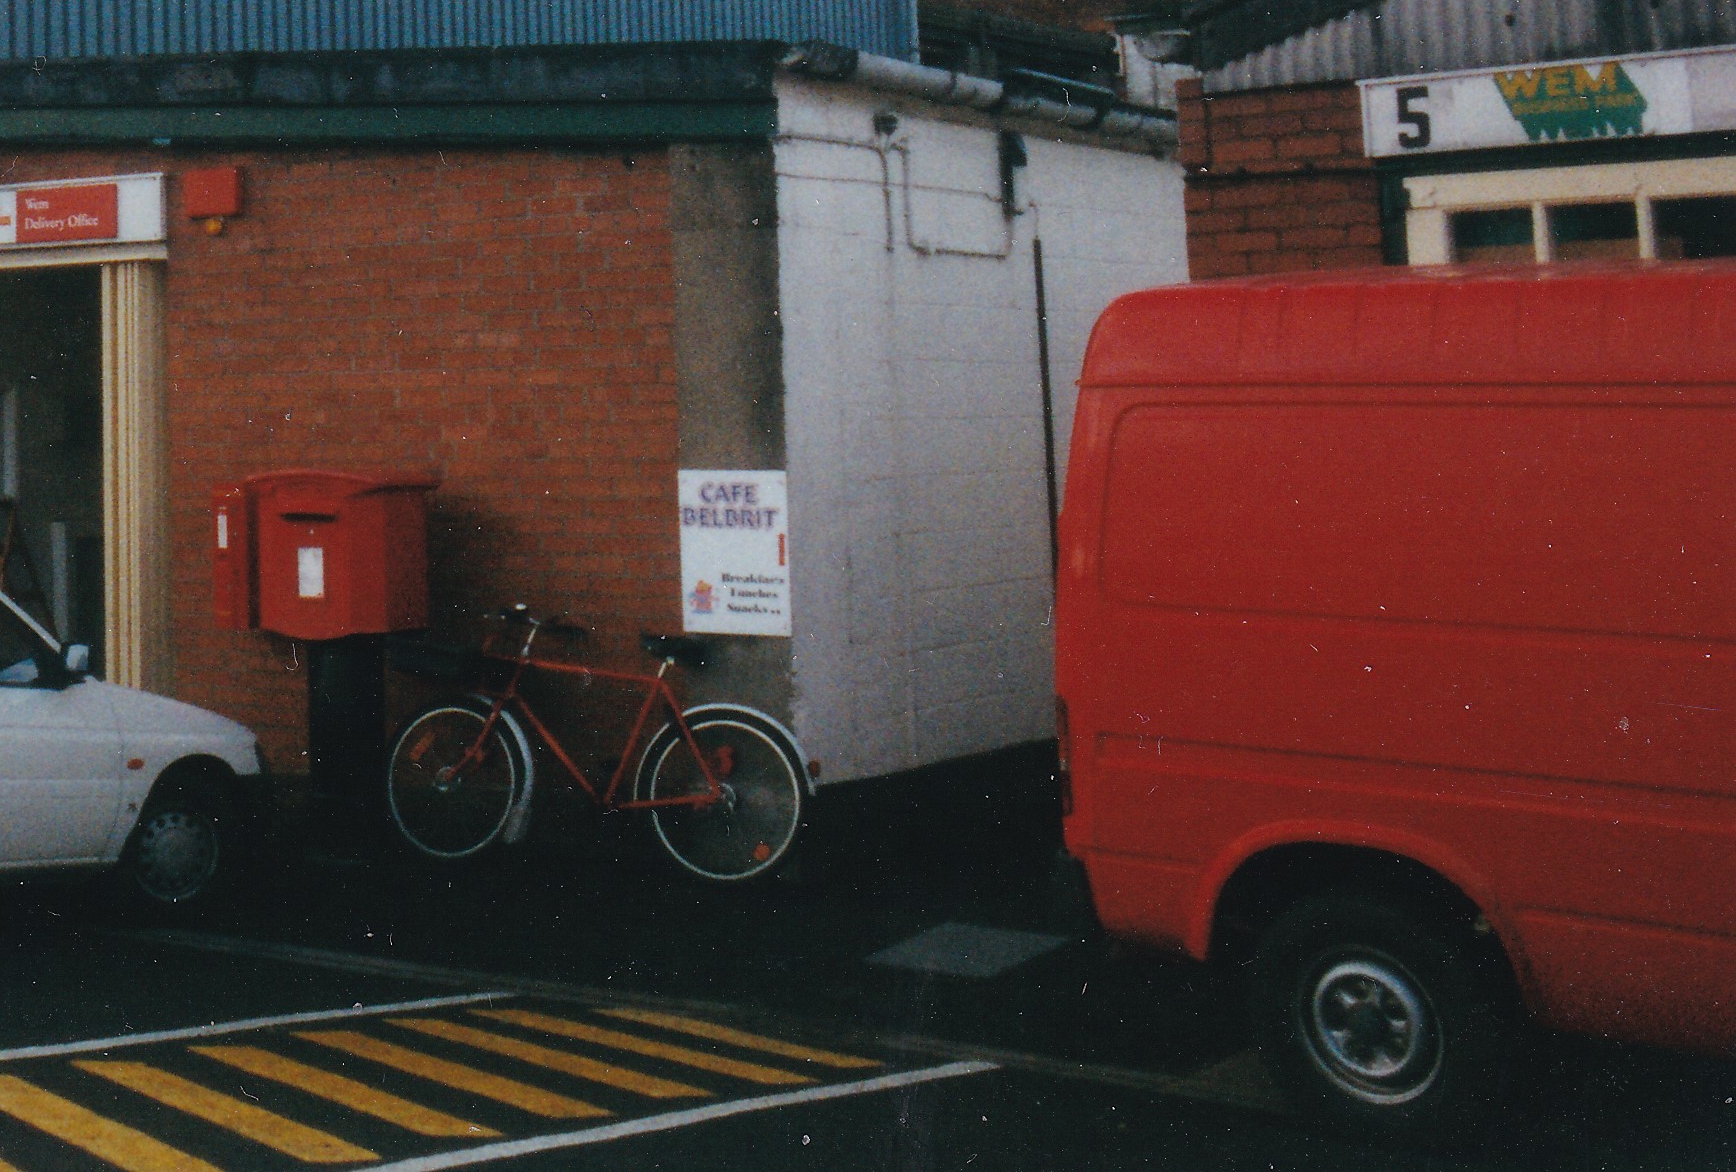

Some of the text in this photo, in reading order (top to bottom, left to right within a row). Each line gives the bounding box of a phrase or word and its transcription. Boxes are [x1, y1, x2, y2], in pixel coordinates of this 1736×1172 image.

[1493, 61, 1620, 100] WEM
[1395, 85, 1431, 149] 5
[25, 198, 49, 210] Wem
[24, 213, 99, 231] Delivery Office
[699, 483, 757, 504] CAFE
